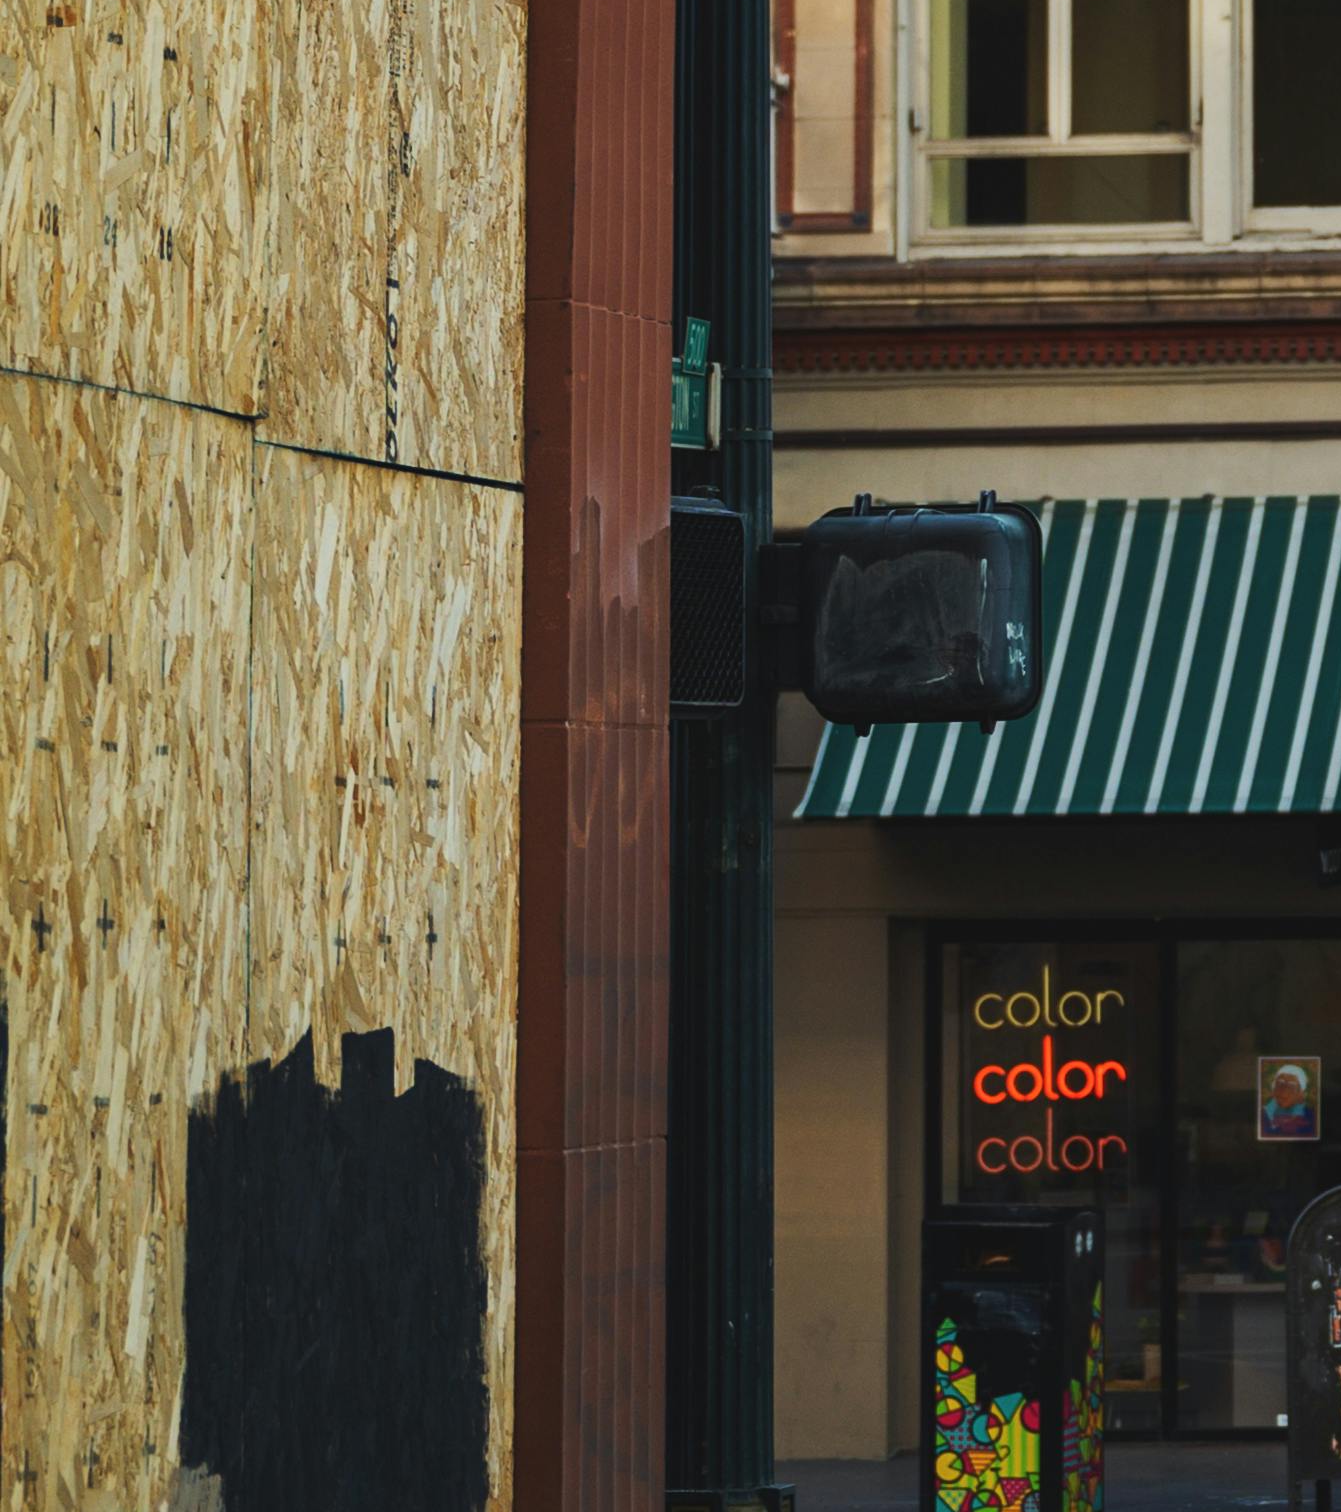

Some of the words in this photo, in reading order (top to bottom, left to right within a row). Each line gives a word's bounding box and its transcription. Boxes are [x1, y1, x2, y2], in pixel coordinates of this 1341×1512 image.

[974, 964, 1125, 1030] color
[973, 1034, 1127, 1105] color
[976, 1107, 1128, 1174] color
